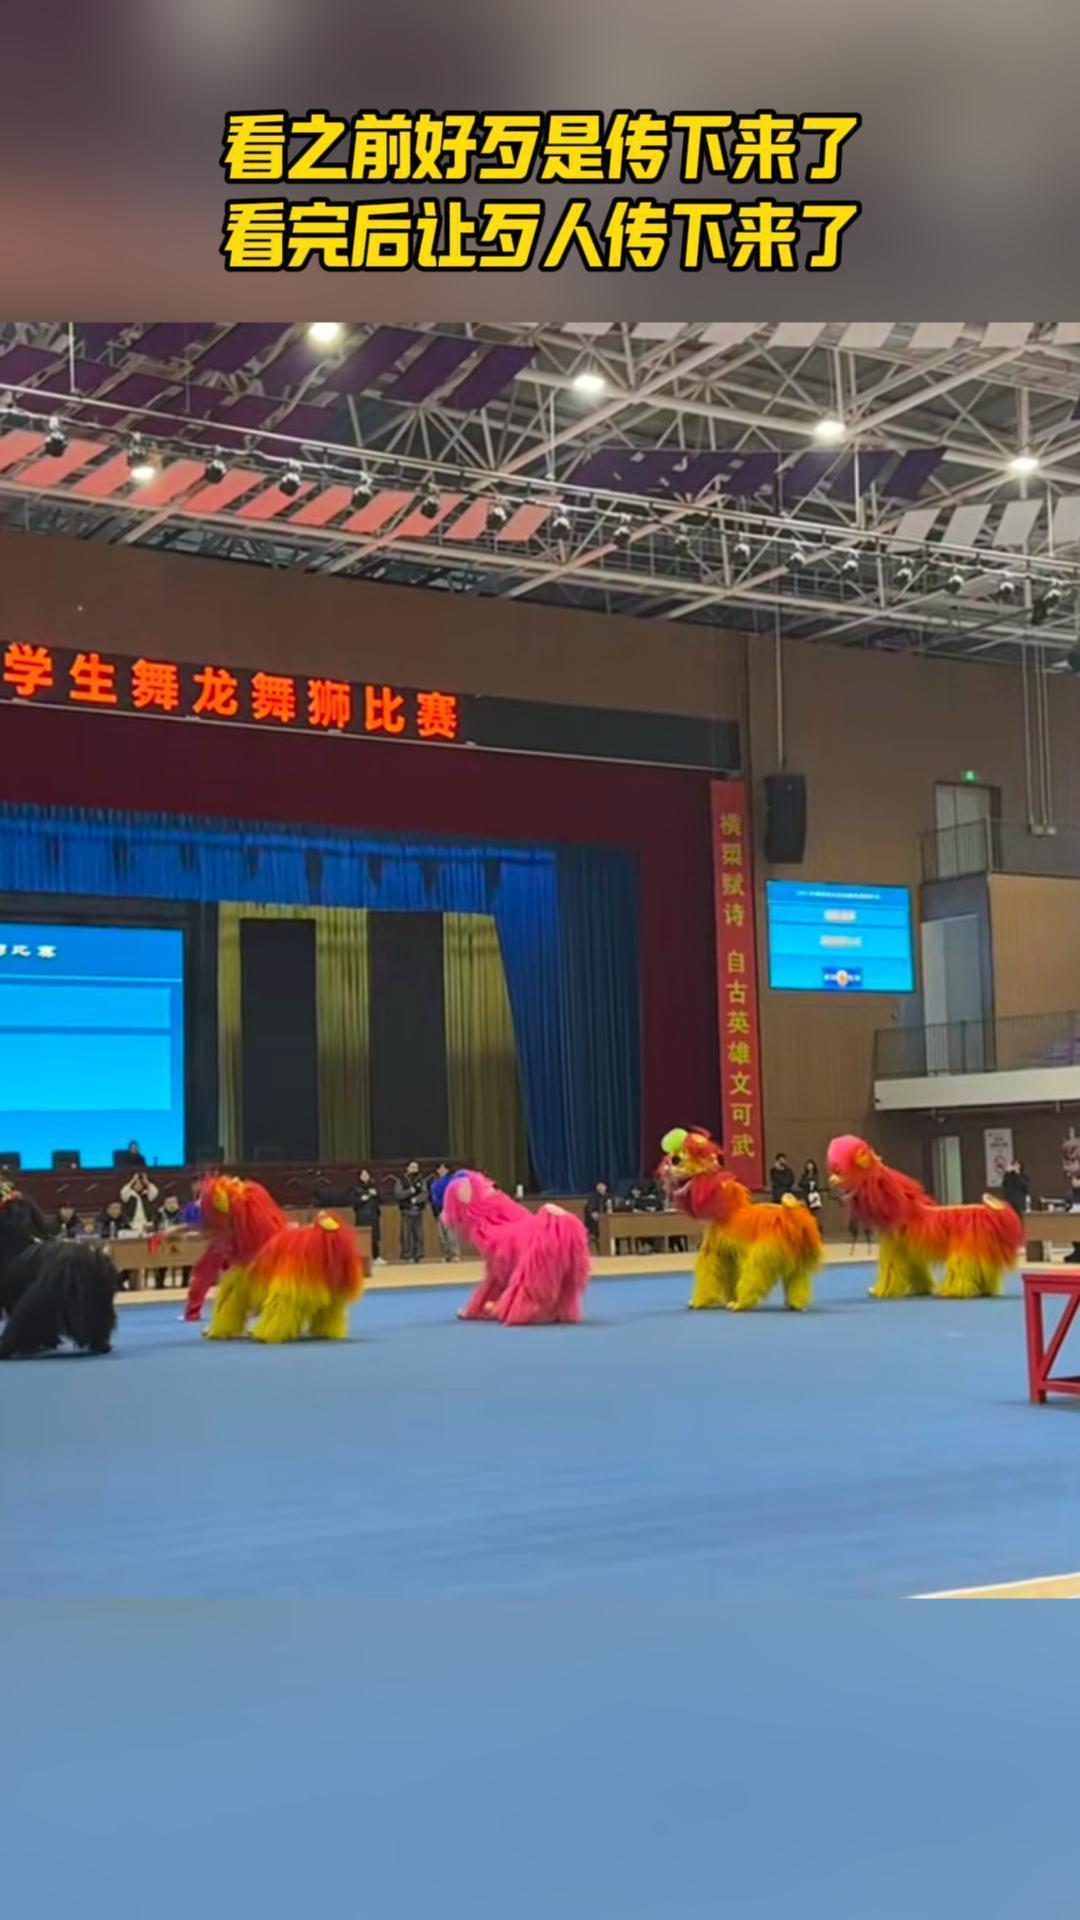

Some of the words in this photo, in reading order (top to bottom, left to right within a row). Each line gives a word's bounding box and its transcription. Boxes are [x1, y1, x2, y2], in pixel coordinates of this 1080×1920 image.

[3, 642, 458, 739] 学生舞龙舞狮比赛
[726, 950, 755, 1157] 自古英雄文可武
